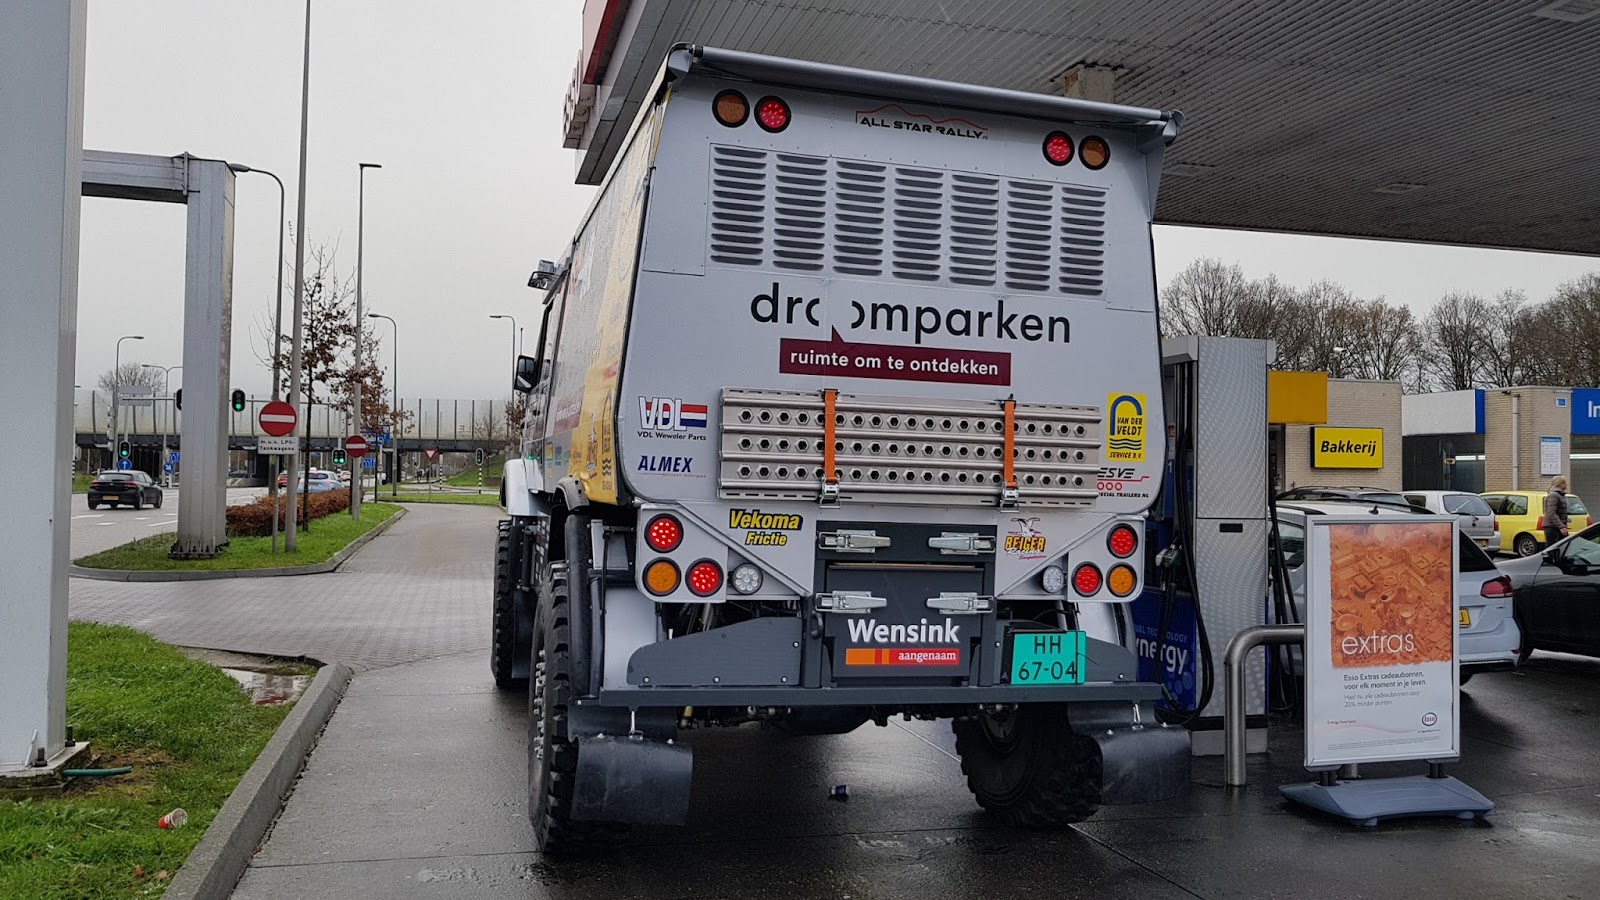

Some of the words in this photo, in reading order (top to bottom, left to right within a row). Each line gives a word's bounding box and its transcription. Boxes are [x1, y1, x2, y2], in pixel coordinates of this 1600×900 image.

[860, 117, 890, 128] ALL
[894, 121, 932, 133] STAR
[790, 349, 849, 367] ruimte
[854, 355, 881, 369] om
[887, 354, 904, 371] te
[910, 356, 999, 376] ontdekken
[638, 396, 687, 431] VDL
[1117, 417, 1129, 425] VAN
[1131, 417, 1143, 425] DER
[637, 430, 653, 438] VDL
[688, 433, 707, 441] Parts
[1117, 425, 1143, 436] VELDT
[1109, 451, 1132, 459] SERVICE
[1320, 440, 1377, 457] Bakkerij
[637, 455, 693, 473] ALMEX
[730, 509, 803, 530] Vekoma
[745, 531, 788, 546] Frictie
[848, 618, 960, 644] Wensink
[1034, 635, 1062, 655] HH
[898, 650, 957, 663] aangenaam
[1019, 660, 1078, 681] 67-04
[1370, 681, 1396, 689] moment
[1403, 680, 1409, 688] je
